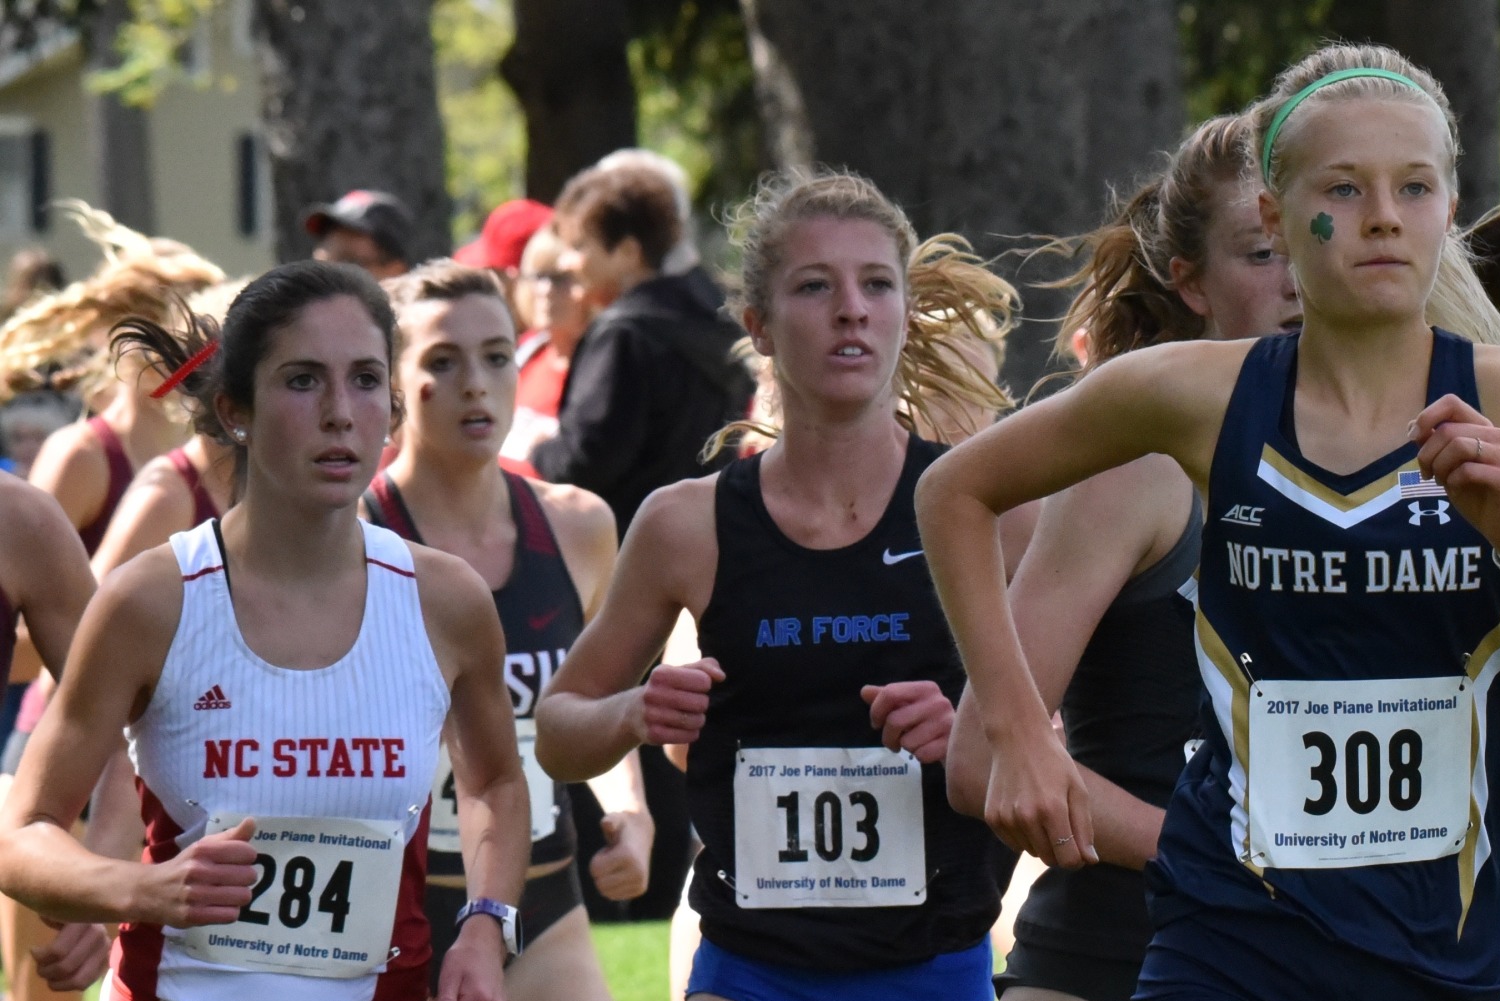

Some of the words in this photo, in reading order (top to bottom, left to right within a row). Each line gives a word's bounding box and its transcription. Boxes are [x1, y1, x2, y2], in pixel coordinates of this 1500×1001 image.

[1223, 504, 1265, 523] ACC
[1226, 541, 1347, 593] NOTRE
[1365, 546, 1481, 593] DAME
[756, 617, 801, 647] AIR
[812, 613, 911, 644] FORCE
[194, 699, 231, 711] adidas
[1267, 700, 1300, 715] 2017
[1304, 700, 1329, 715] Joe
[1333, 700, 1374, 715] Piane
[1378, 696, 1457, 713] Invitational
[203, 739, 259, 778] NC
[273, 738, 405, 778] STATE
[749, 765, 776, 777] 2017
[779, 765, 800, 777] Joe
[804, 765, 838, 777] Piane
[840, 763, 908, 776] Invitational
[1302, 728, 1423, 816] 308
[776, 790, 880, 863] 103
[1274, 832, 1347, 849] University
[1351, 831, 1365, 845] of
[1369, 829, 1406, 844] Notre
[1410, 826, 1448, 840] Dame
[254, 830, 277, 841] Joe
[280, 831, 315, 843] Piane
[319, 832, 391, 850] Invitational
[238, 853, 354, 933] 284
[756, 877, 817, 892] University
[819, 876, 832, 888] of
[835, 876, 868, 889] Notre
[871, 876, 906, 888] Dame
[208, 934, 273, 955] University
[277, 943, 291, 955] of
[294, 944, 328, 959] Notre
[332, 947, 368, 962] Dame
